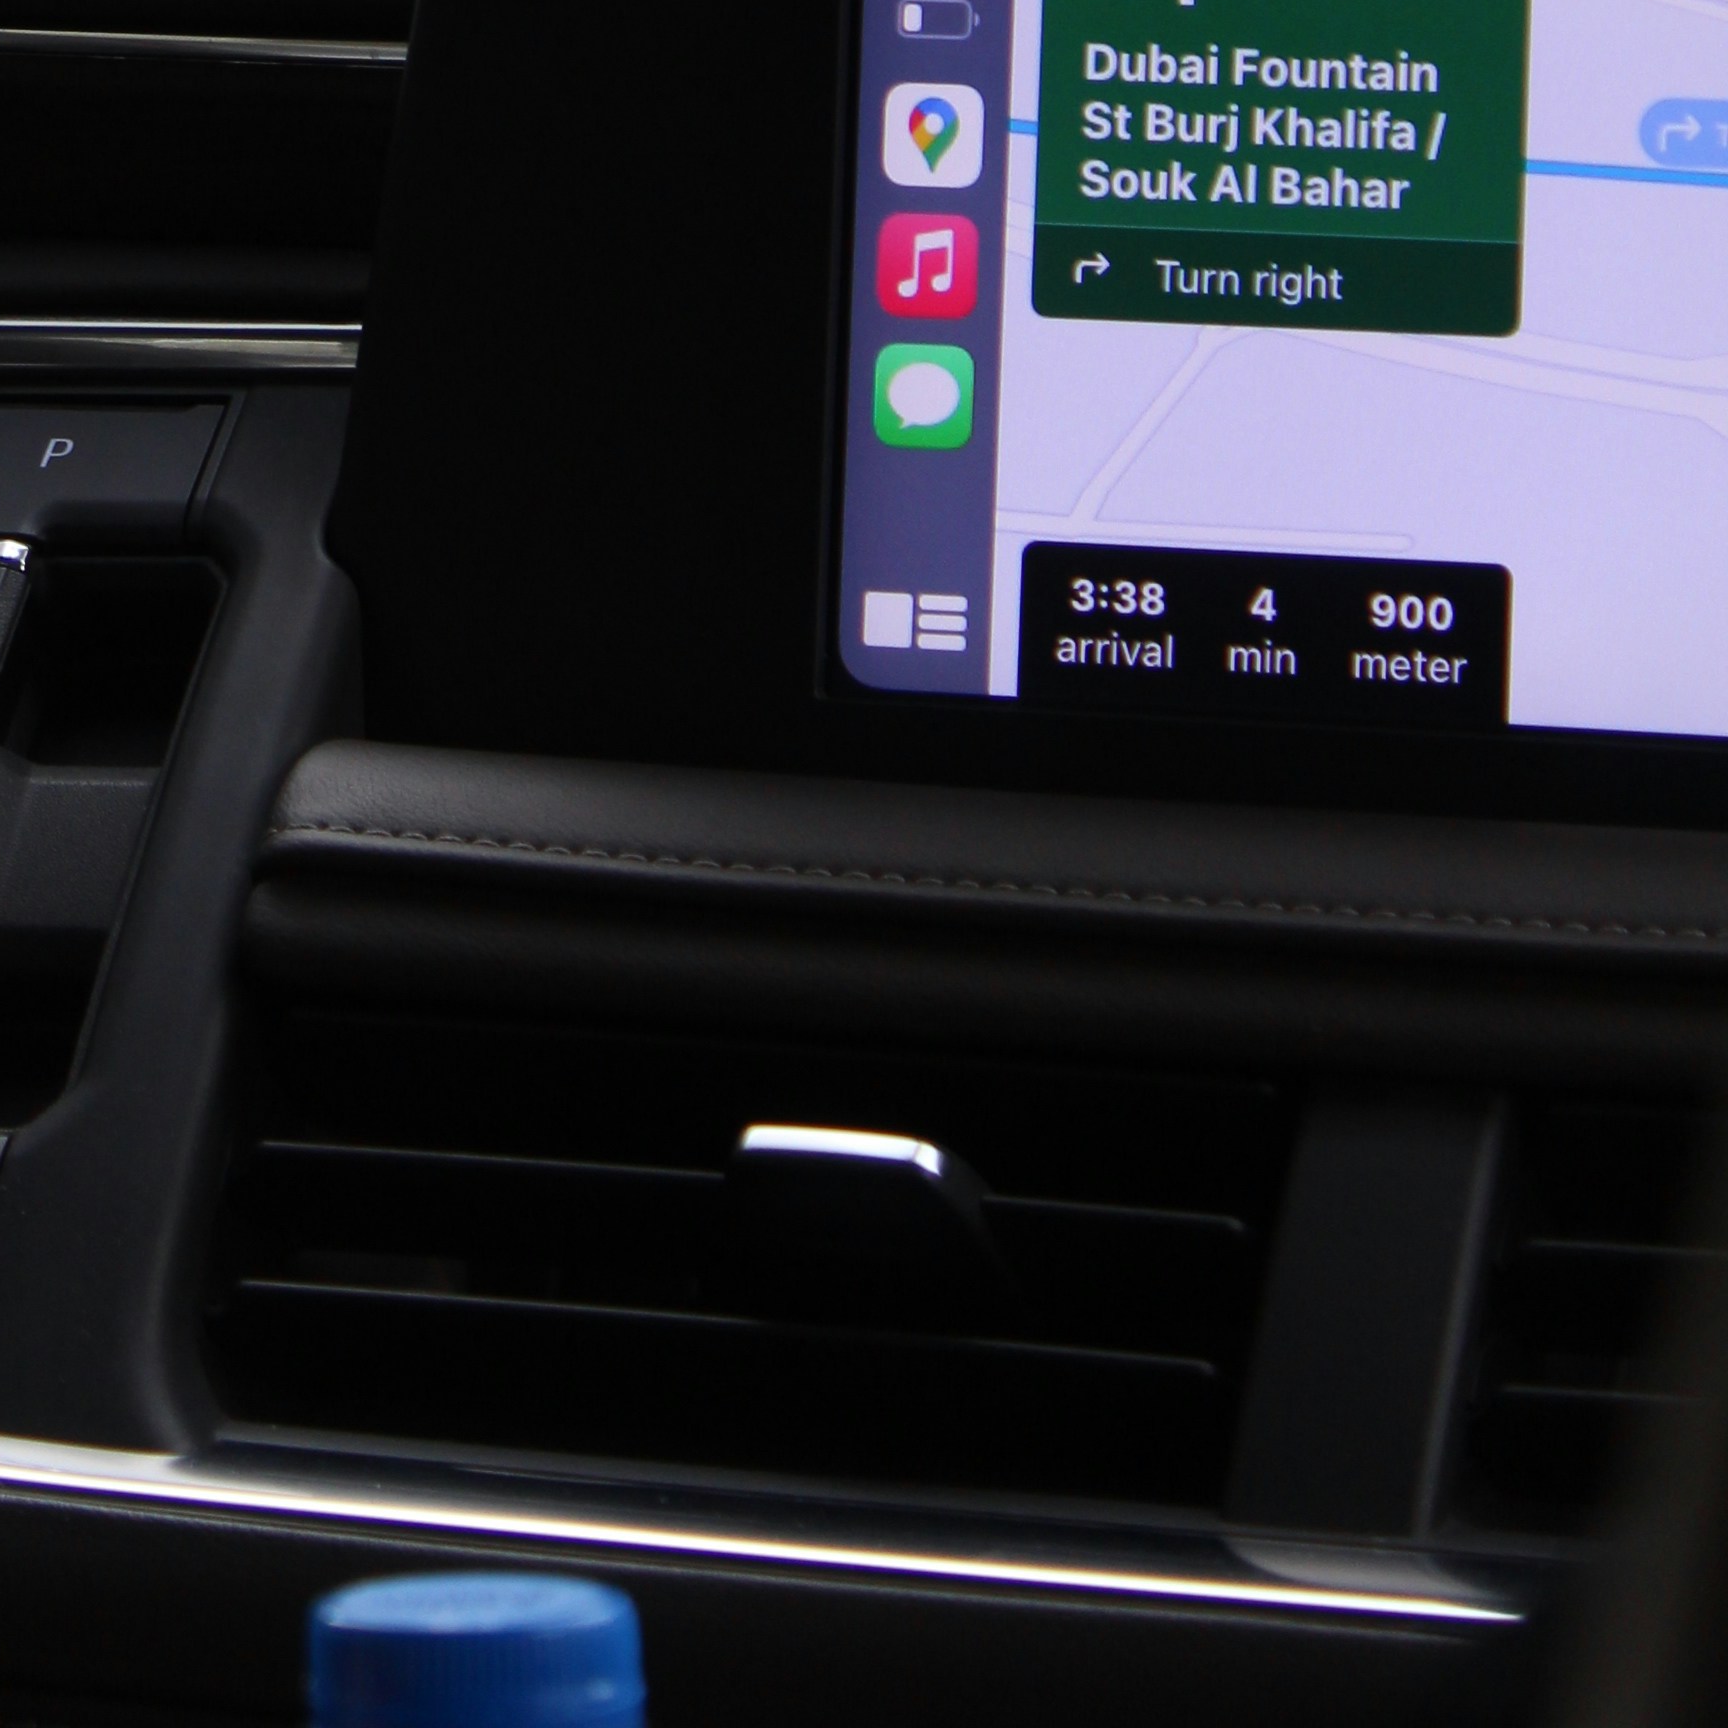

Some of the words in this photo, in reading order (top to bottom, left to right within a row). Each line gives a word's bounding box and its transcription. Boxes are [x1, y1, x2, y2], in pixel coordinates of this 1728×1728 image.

[1085, 42, 1219, 85] Dubai
[1232, 47, 1438, 93] Fountain
[1082, 101, 1132, 140] St
[1145, 103, 1239, 153] Burj
[1252, 106, 1416, 151] Khalifa
[1426, 112, 1447, 161] /
[1080, 159, 1197, 201] Souk
[1209, 163, 1257, 204] Al
[1270, 166, 1411, 209] Bahar
[1155, 259, 1240, 296] Turn
[1254, 263, 1343, 306] right
[39, 438, 74, 468] P
[1071, 578, 1165, 616] 3:38
[1250, 587, 1277, 622] 4
[1370, 593, 1454, 631] 900
[1056, 631, 1173, 669] arrival
[1228, 646, 1296, 675] min
[1353, 650, 1468, 684] meter
